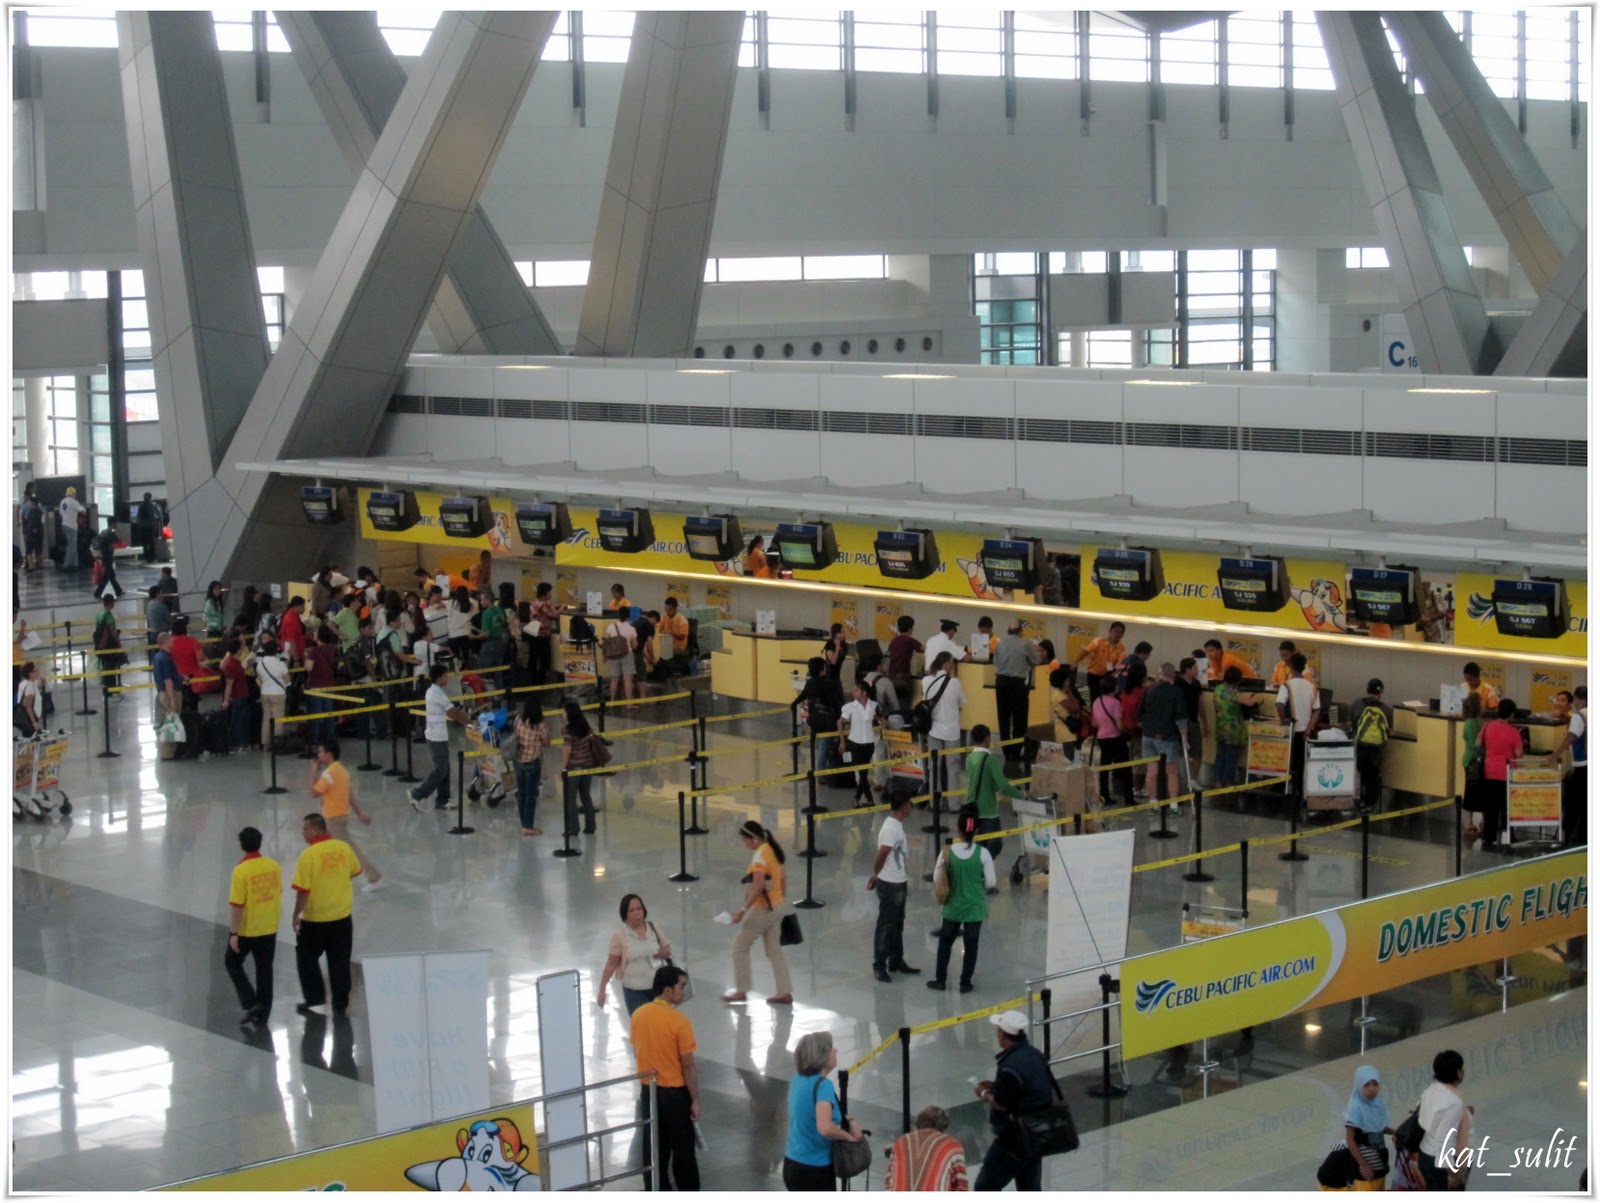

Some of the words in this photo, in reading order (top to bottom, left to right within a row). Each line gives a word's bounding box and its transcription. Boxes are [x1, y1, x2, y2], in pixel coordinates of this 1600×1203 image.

[1389, 341, 1405, 367] C
[1407, 356, 1418, 368] 16
[583, 536, 602, 549] CEB
[1245, 560, 1254, 568] 26
[1373, 570, 1379, 578] D
[1164, 582, 1208, 599] ACIFIC
[1516, 582, 1522, 590] D
[1523, 583, 1532, 591] 28
[1377, 892, 1512, 963] DOMESTIC
[1165, 985, 1202, 1009] CEBU
[1206, 971, 1257, 999] PACIFIC
[1259, 956, 1315, 985] AIR.COM
